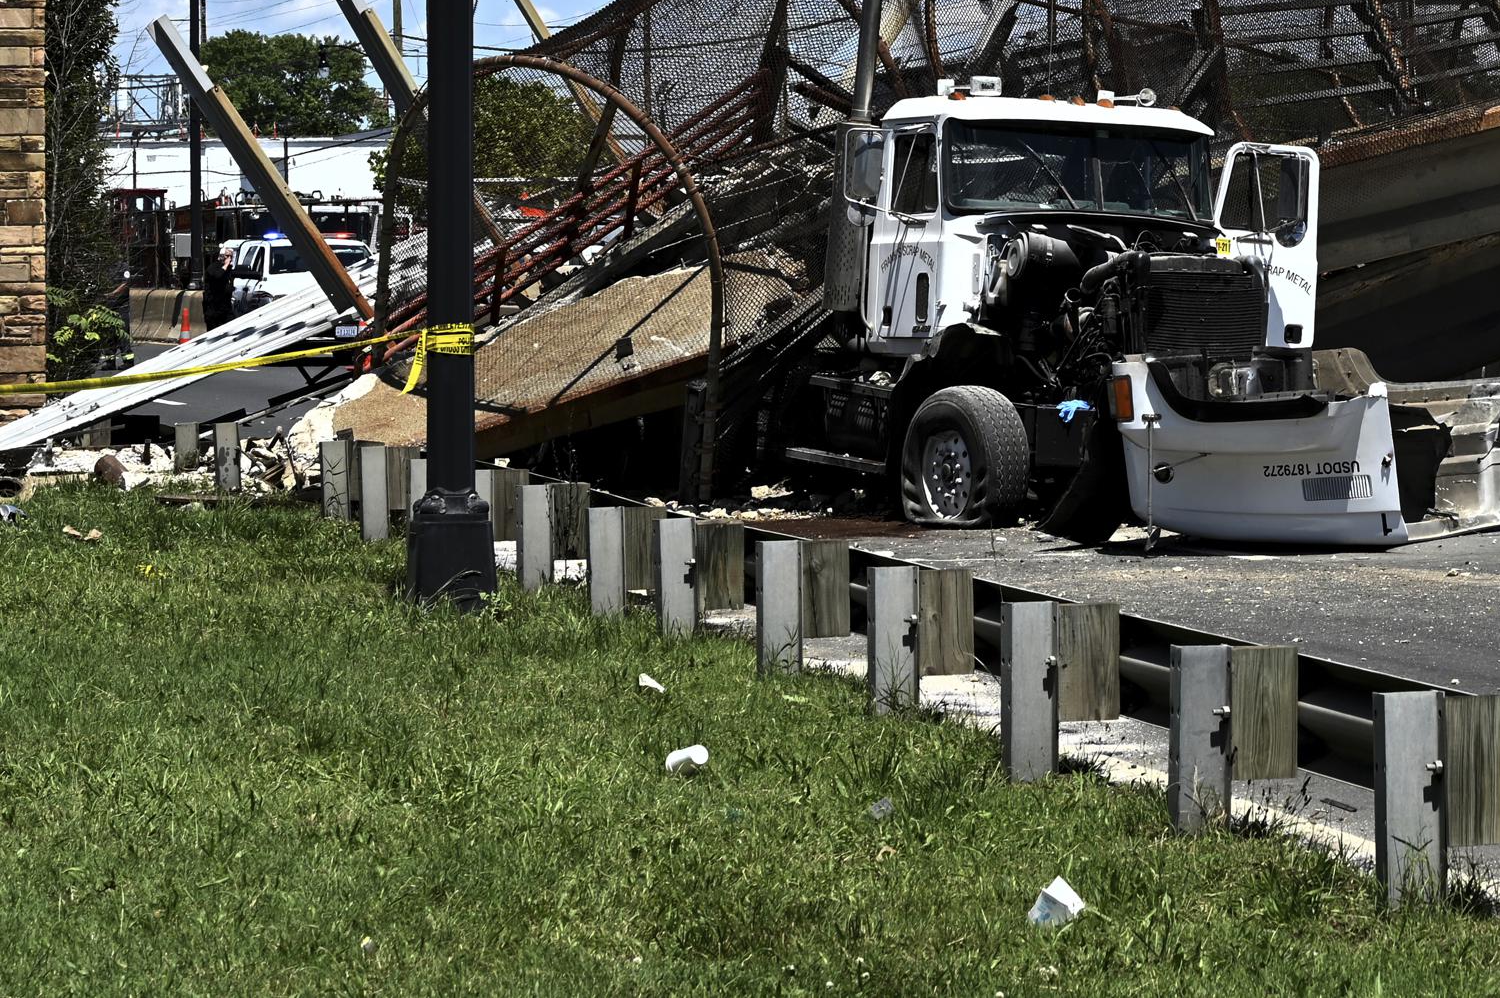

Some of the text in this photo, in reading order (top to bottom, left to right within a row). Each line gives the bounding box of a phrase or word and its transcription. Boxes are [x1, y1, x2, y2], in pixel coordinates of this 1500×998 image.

[919, 248, 935, 273] METAL
[1285, 270, 1313, 296] METAL
[1263, 461, 1361, 478] USDOT 1879272
